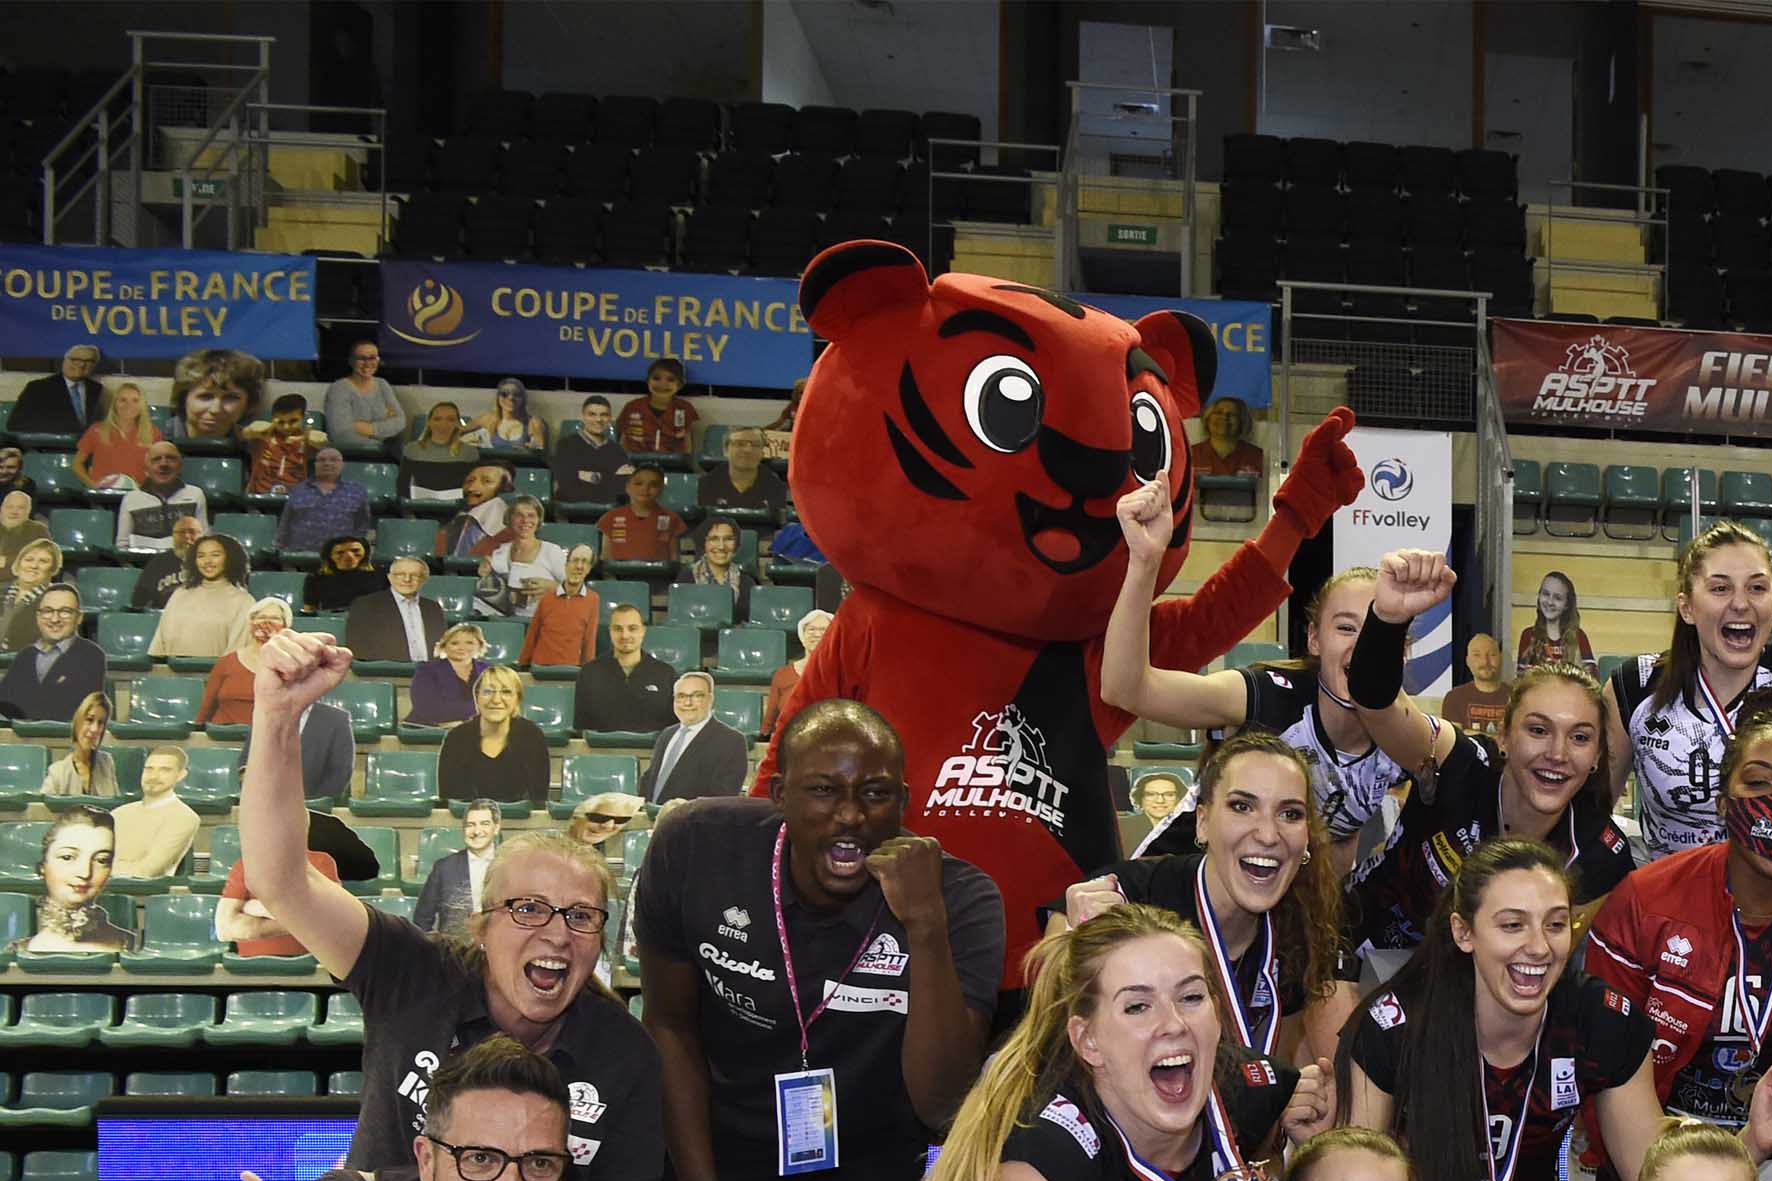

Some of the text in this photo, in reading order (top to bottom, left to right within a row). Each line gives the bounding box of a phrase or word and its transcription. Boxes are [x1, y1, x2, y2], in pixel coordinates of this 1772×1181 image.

[0, 268, 311, 301] OUPE DE FRANCE
[51, 304, 228, 336] DE VOLLEY
[491, 287, 809, 333] COUPE DE FRANCE
[559, 326, 729, 363] DE VOLLEY
[1539, 372, 1657, 401] ASPTT
[1533, 396, 1648, 415] MULHOUSE
[1353, 509, 1430, 531] FFvolley
[1640, 735, 1670, 751] errea
[935, 755, 1069, 808] ASPTT
[926, 788, 1065, 829] MULHOUSE
[1659, 826, 1697, 844] Crédit
[718, 924, 748, 943] errea
[699, 942, 776, 981] Ricola
[832, 994, 878, 1004] VINCI
